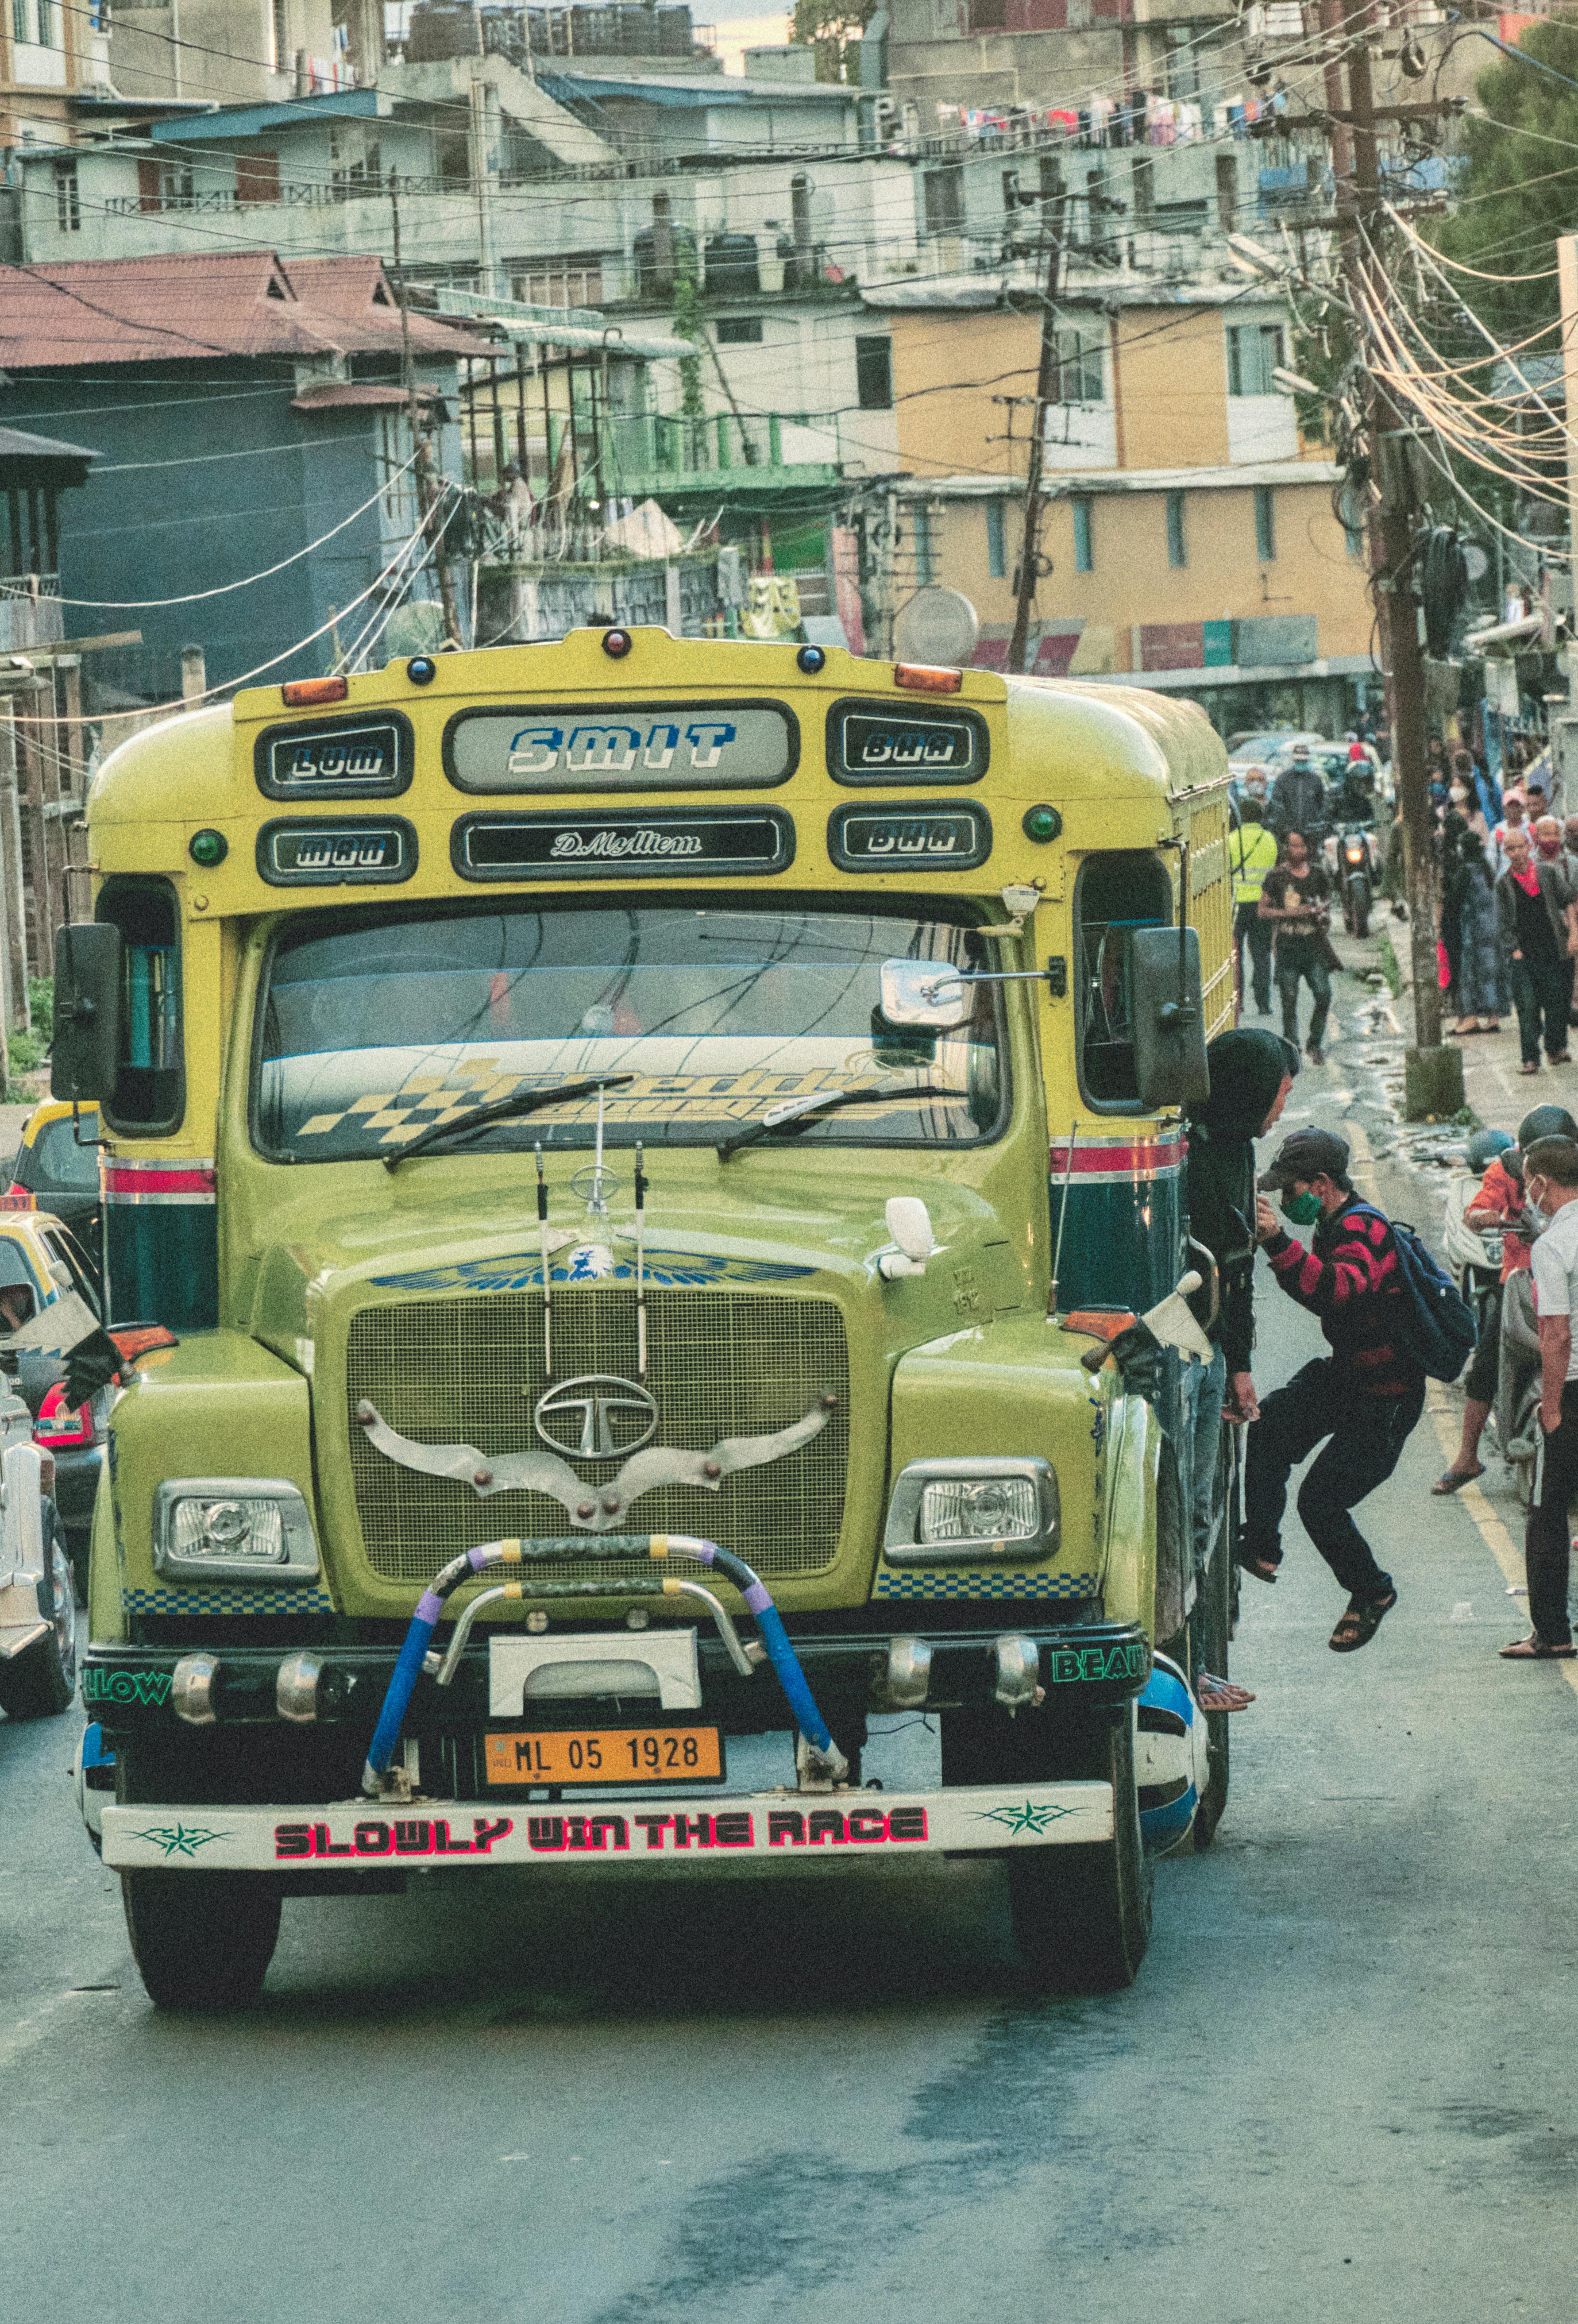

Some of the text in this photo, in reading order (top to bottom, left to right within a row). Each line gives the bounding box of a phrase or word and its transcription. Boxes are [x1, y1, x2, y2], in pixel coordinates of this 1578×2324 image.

[508, 723, 736, 773] SMIT
[1051, 1644, 1147, 1682] BEAU
[81, 1668, 173, 1706] LLOW
[515, 1736, 699, 1771] ML 05 1928
[274, 1807, 929, 1859] SLOWLY WIN THE RACE
